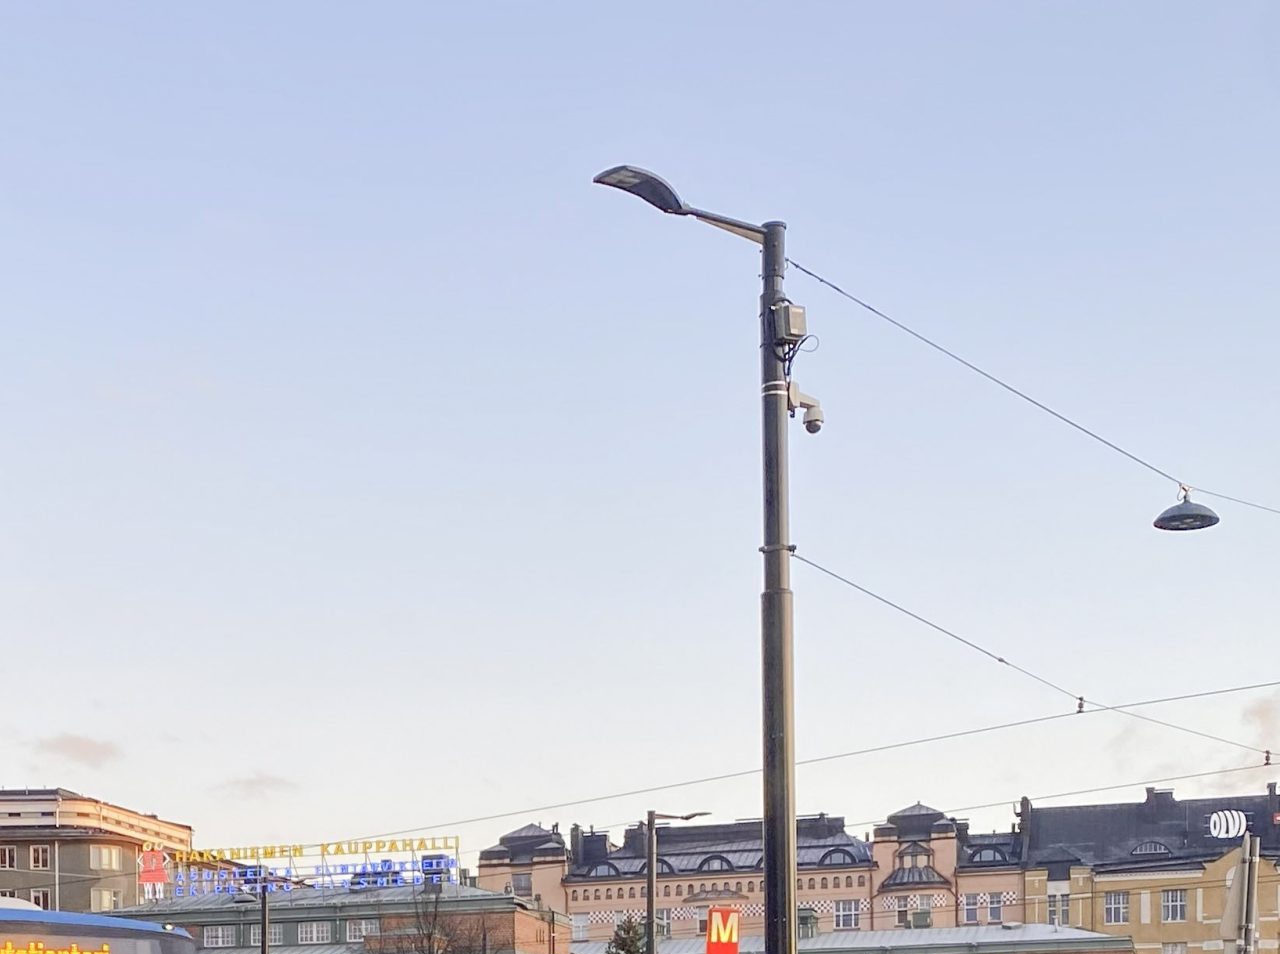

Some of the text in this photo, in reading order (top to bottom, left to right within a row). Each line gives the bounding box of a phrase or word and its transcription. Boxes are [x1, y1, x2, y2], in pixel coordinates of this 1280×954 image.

[175, 836, 460, 863] HAKANIEMEN KAUPPAHALLI
[710, 911, 739, 943] M
